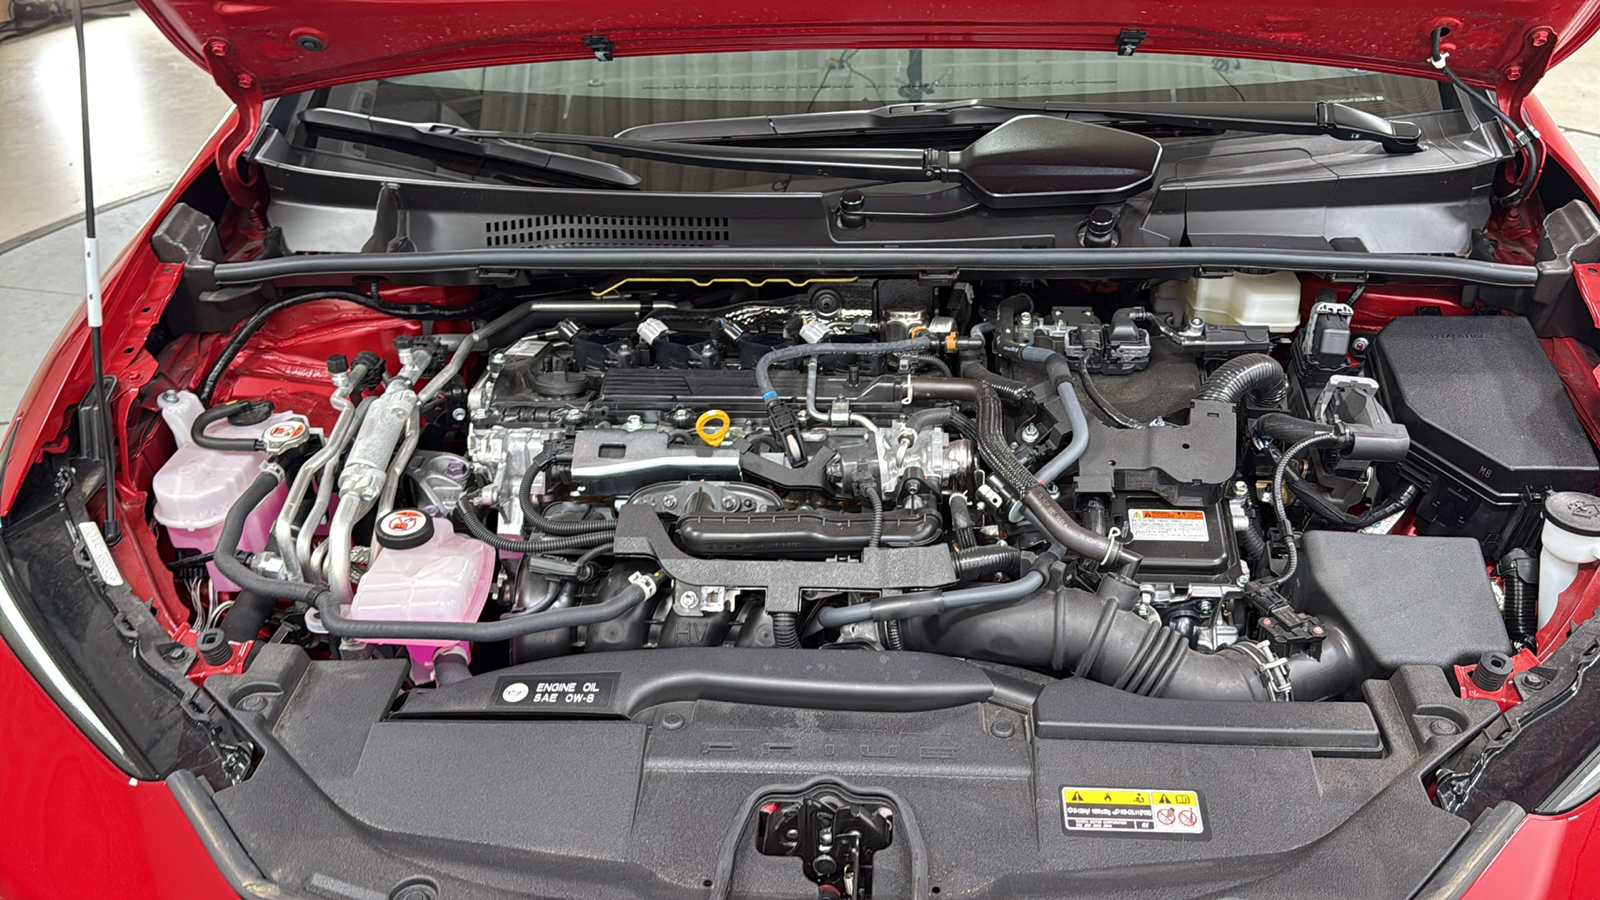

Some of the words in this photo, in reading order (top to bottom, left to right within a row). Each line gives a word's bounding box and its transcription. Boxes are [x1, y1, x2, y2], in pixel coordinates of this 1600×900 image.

[1478, 465, 1492, 478] M8
[674, 622, 708, 642] HV
[536, 682, 577, 692] ENGINE
[583, 682, 600, 692] OIL
[533, 693, 558, 703] SAE
[701, 742, 960, 760] PRIUS
